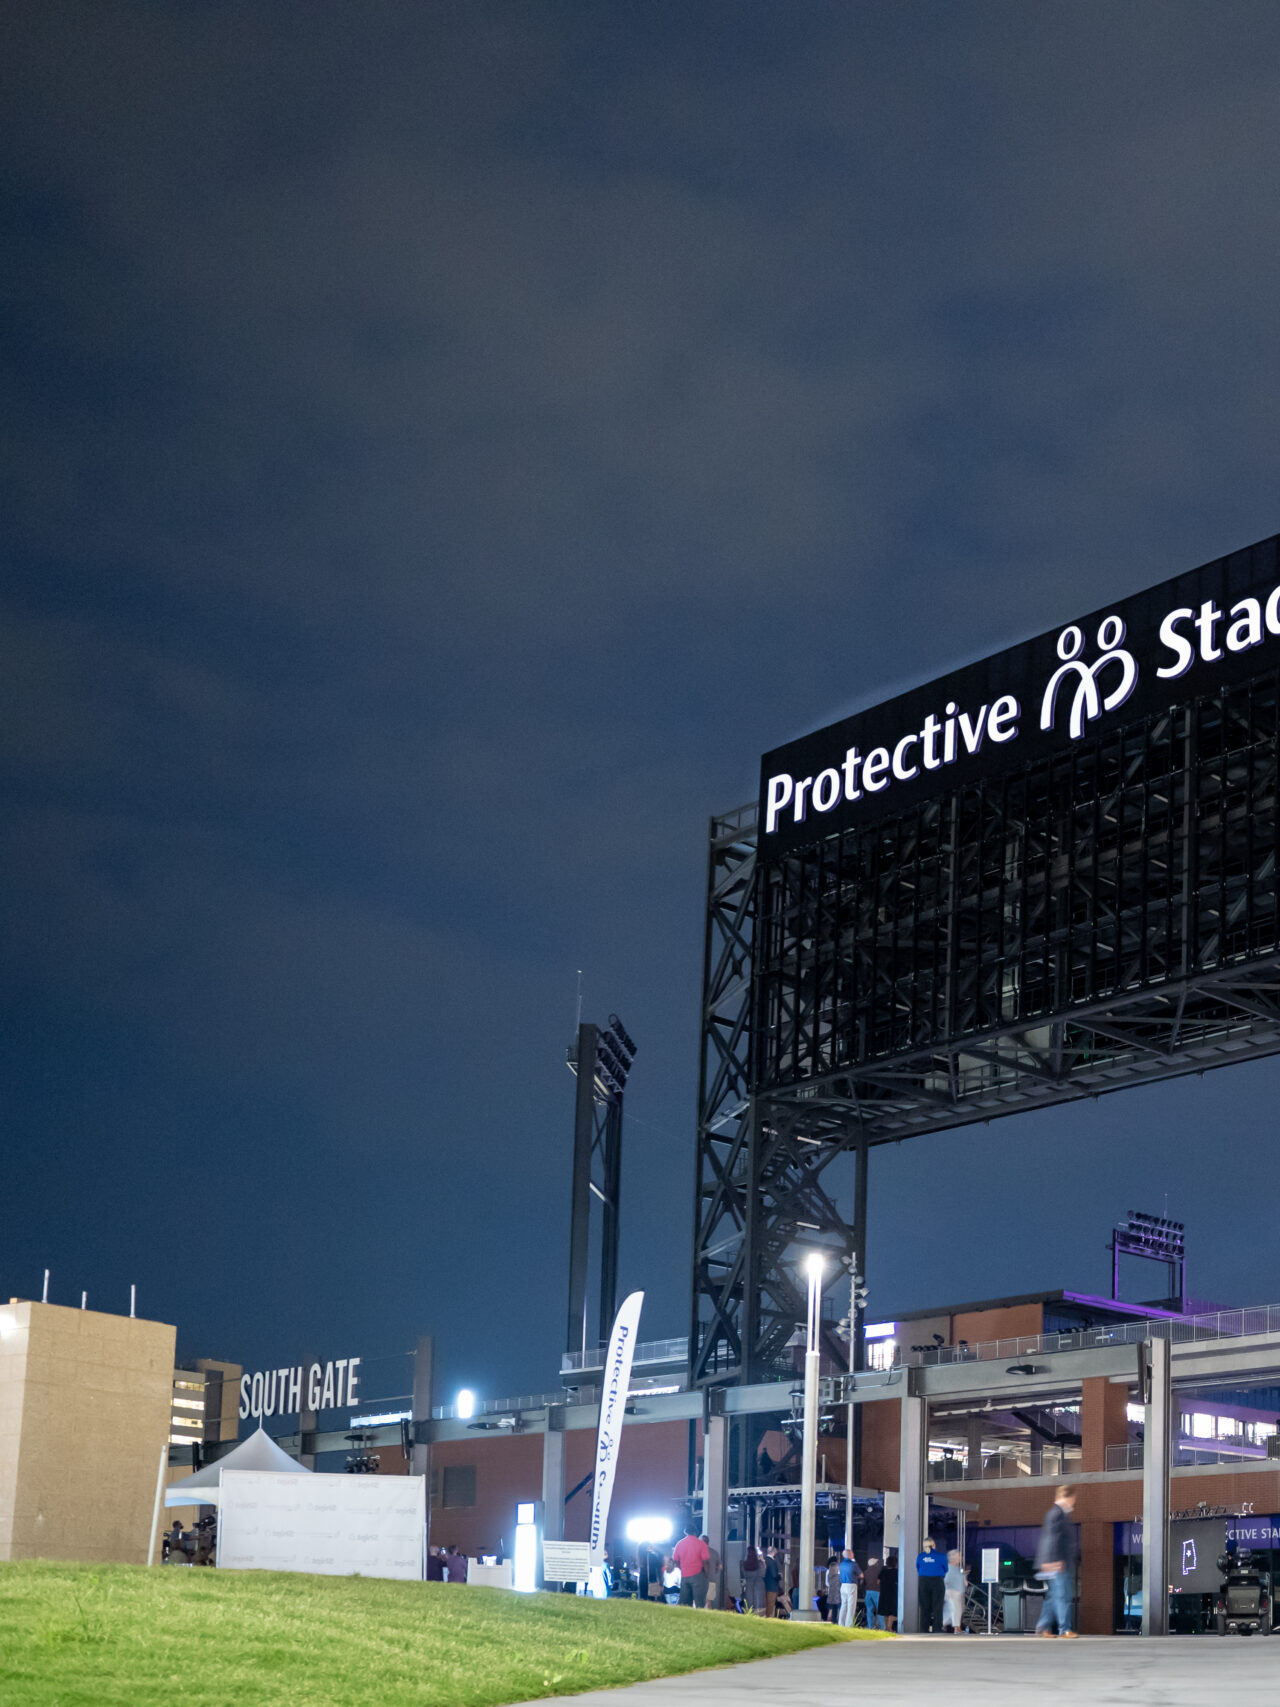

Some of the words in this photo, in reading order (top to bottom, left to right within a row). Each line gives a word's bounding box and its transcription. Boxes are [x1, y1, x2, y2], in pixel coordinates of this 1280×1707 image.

[766, 696, 1017, 832] Protective
[239, 1366, 303, 1420] SOUTH
[308, 1357, 361, 1411] GATE
[606, 1325, 629, 1425] Protective
[1228, 1528, 1258, 1540] CTIVE
